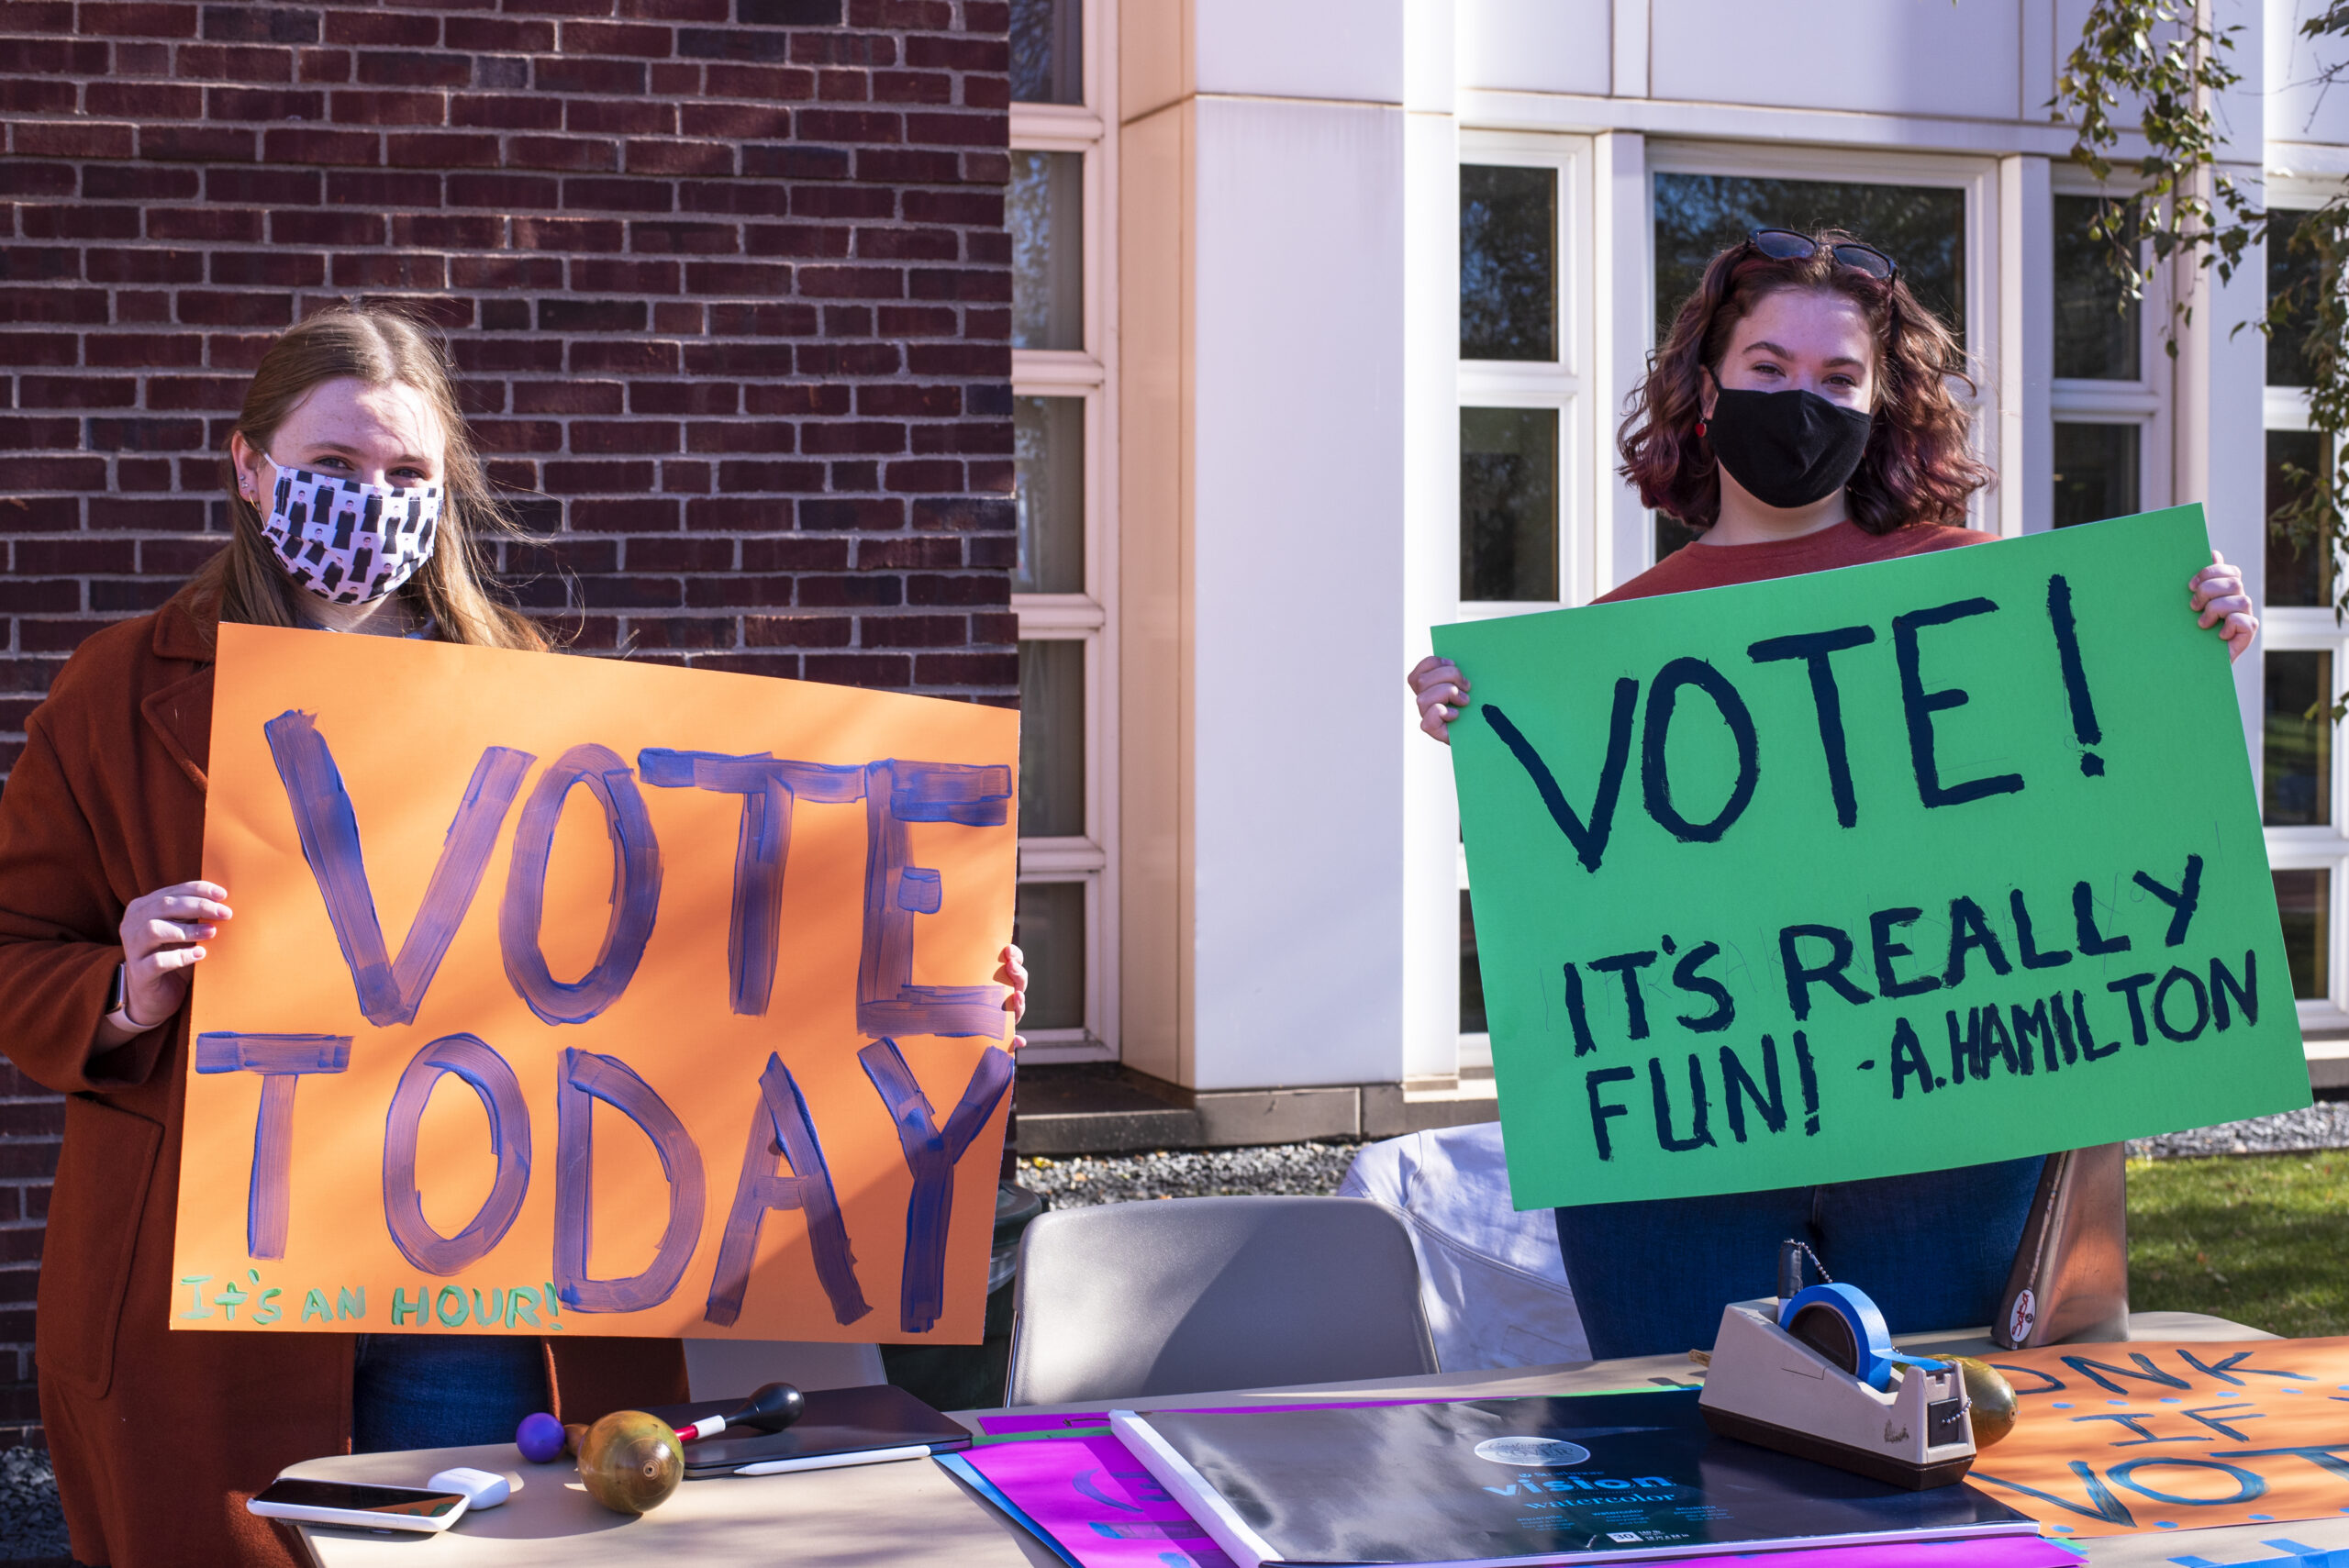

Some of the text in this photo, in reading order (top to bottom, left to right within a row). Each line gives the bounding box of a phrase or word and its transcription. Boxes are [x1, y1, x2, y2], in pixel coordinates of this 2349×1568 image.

[1481, 573, 2104, 873] VOTE!
[264, 709, 1011, 1040] VOTE
[1564, 934, 1735, 1057] IT'S
[1778, 853, 2203, 1020] REALLY
[1586, 1029, 1820, 1162] FUN!
[195, 1033, 1014, 1333] TODAY
[301, 1286, 366, 1324] AN
[391, 1282, 564, 1330] HOUR!
[1482, 1475, 1674, 1497] vision
[2067, 1403, 2266, 1447] IF
[1523, 1493, 1675, 1509] watercolor
